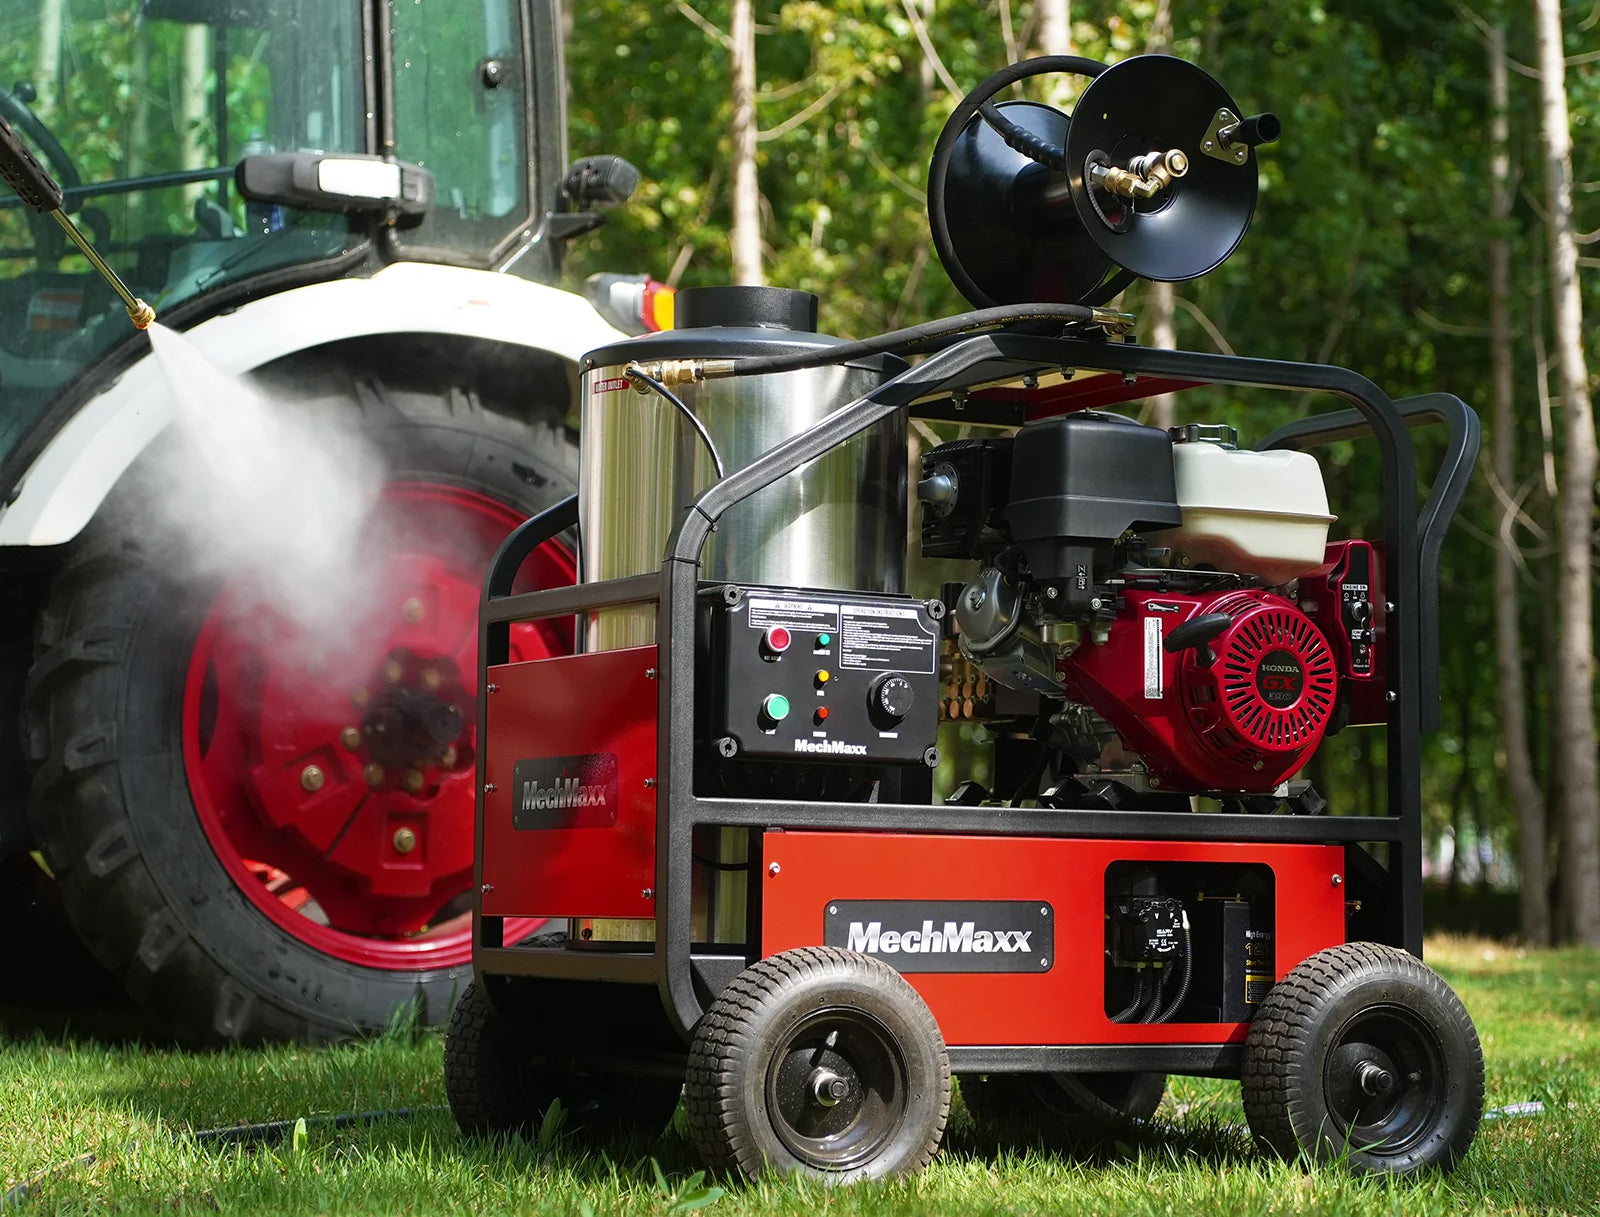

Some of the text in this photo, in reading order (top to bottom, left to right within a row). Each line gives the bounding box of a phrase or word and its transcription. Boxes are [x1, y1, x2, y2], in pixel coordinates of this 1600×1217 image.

[1262, 664, 1300, 673] HONDA
[1262, 674, 1298, 691] GX
[794, 738, 868, 756] MechMaxx
[522, 777, 608, 811] MechMaxx
[846, 920, 1032, 953] MechMaxx
[1245, 930, 1256, 939] High
